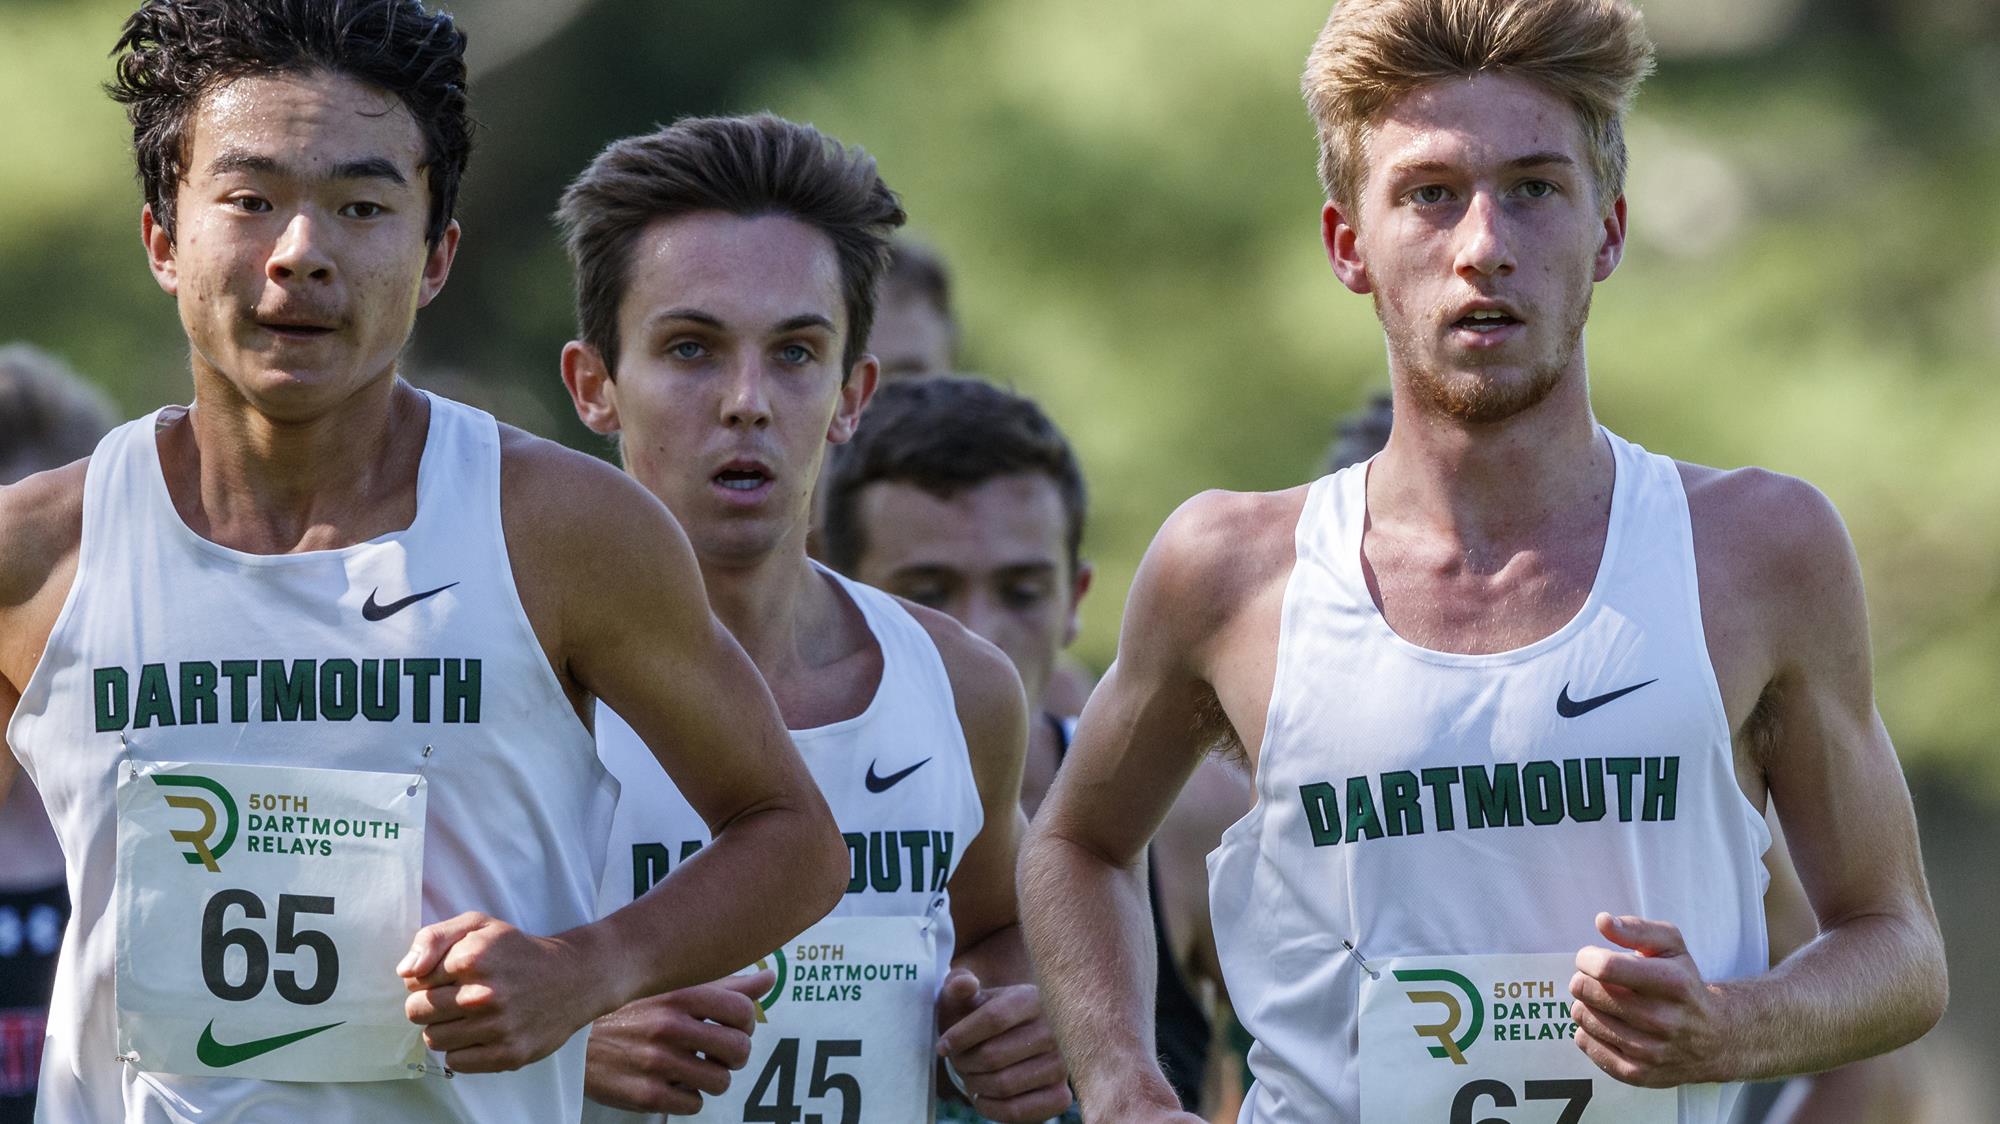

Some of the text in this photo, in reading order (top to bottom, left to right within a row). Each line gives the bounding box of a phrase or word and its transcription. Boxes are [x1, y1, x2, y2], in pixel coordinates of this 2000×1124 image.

[94, 658, 482, 733] DARTMOUTH
[248, 793, 308, 813] 50TH
[1299, 756, 1680, 847] DARTMOUTH
[247, 814, 400, 840] DARTMOUTH
[247, 835, 332, 857] RELAYS
[632, 830, 954, 900] DOUTH
[200, 889, 340, 1005] 65
[796, 945, 844, 961] 50TH
[794, 964, 917, 982] DARTMOUTH
[792, 985, 862, 1002] RELAYS
[1494, 981, 1554, 999] 50TH
[1493, 1002, 1574, 1020] DARTM
[743, 1037, 862, 1124] 45
